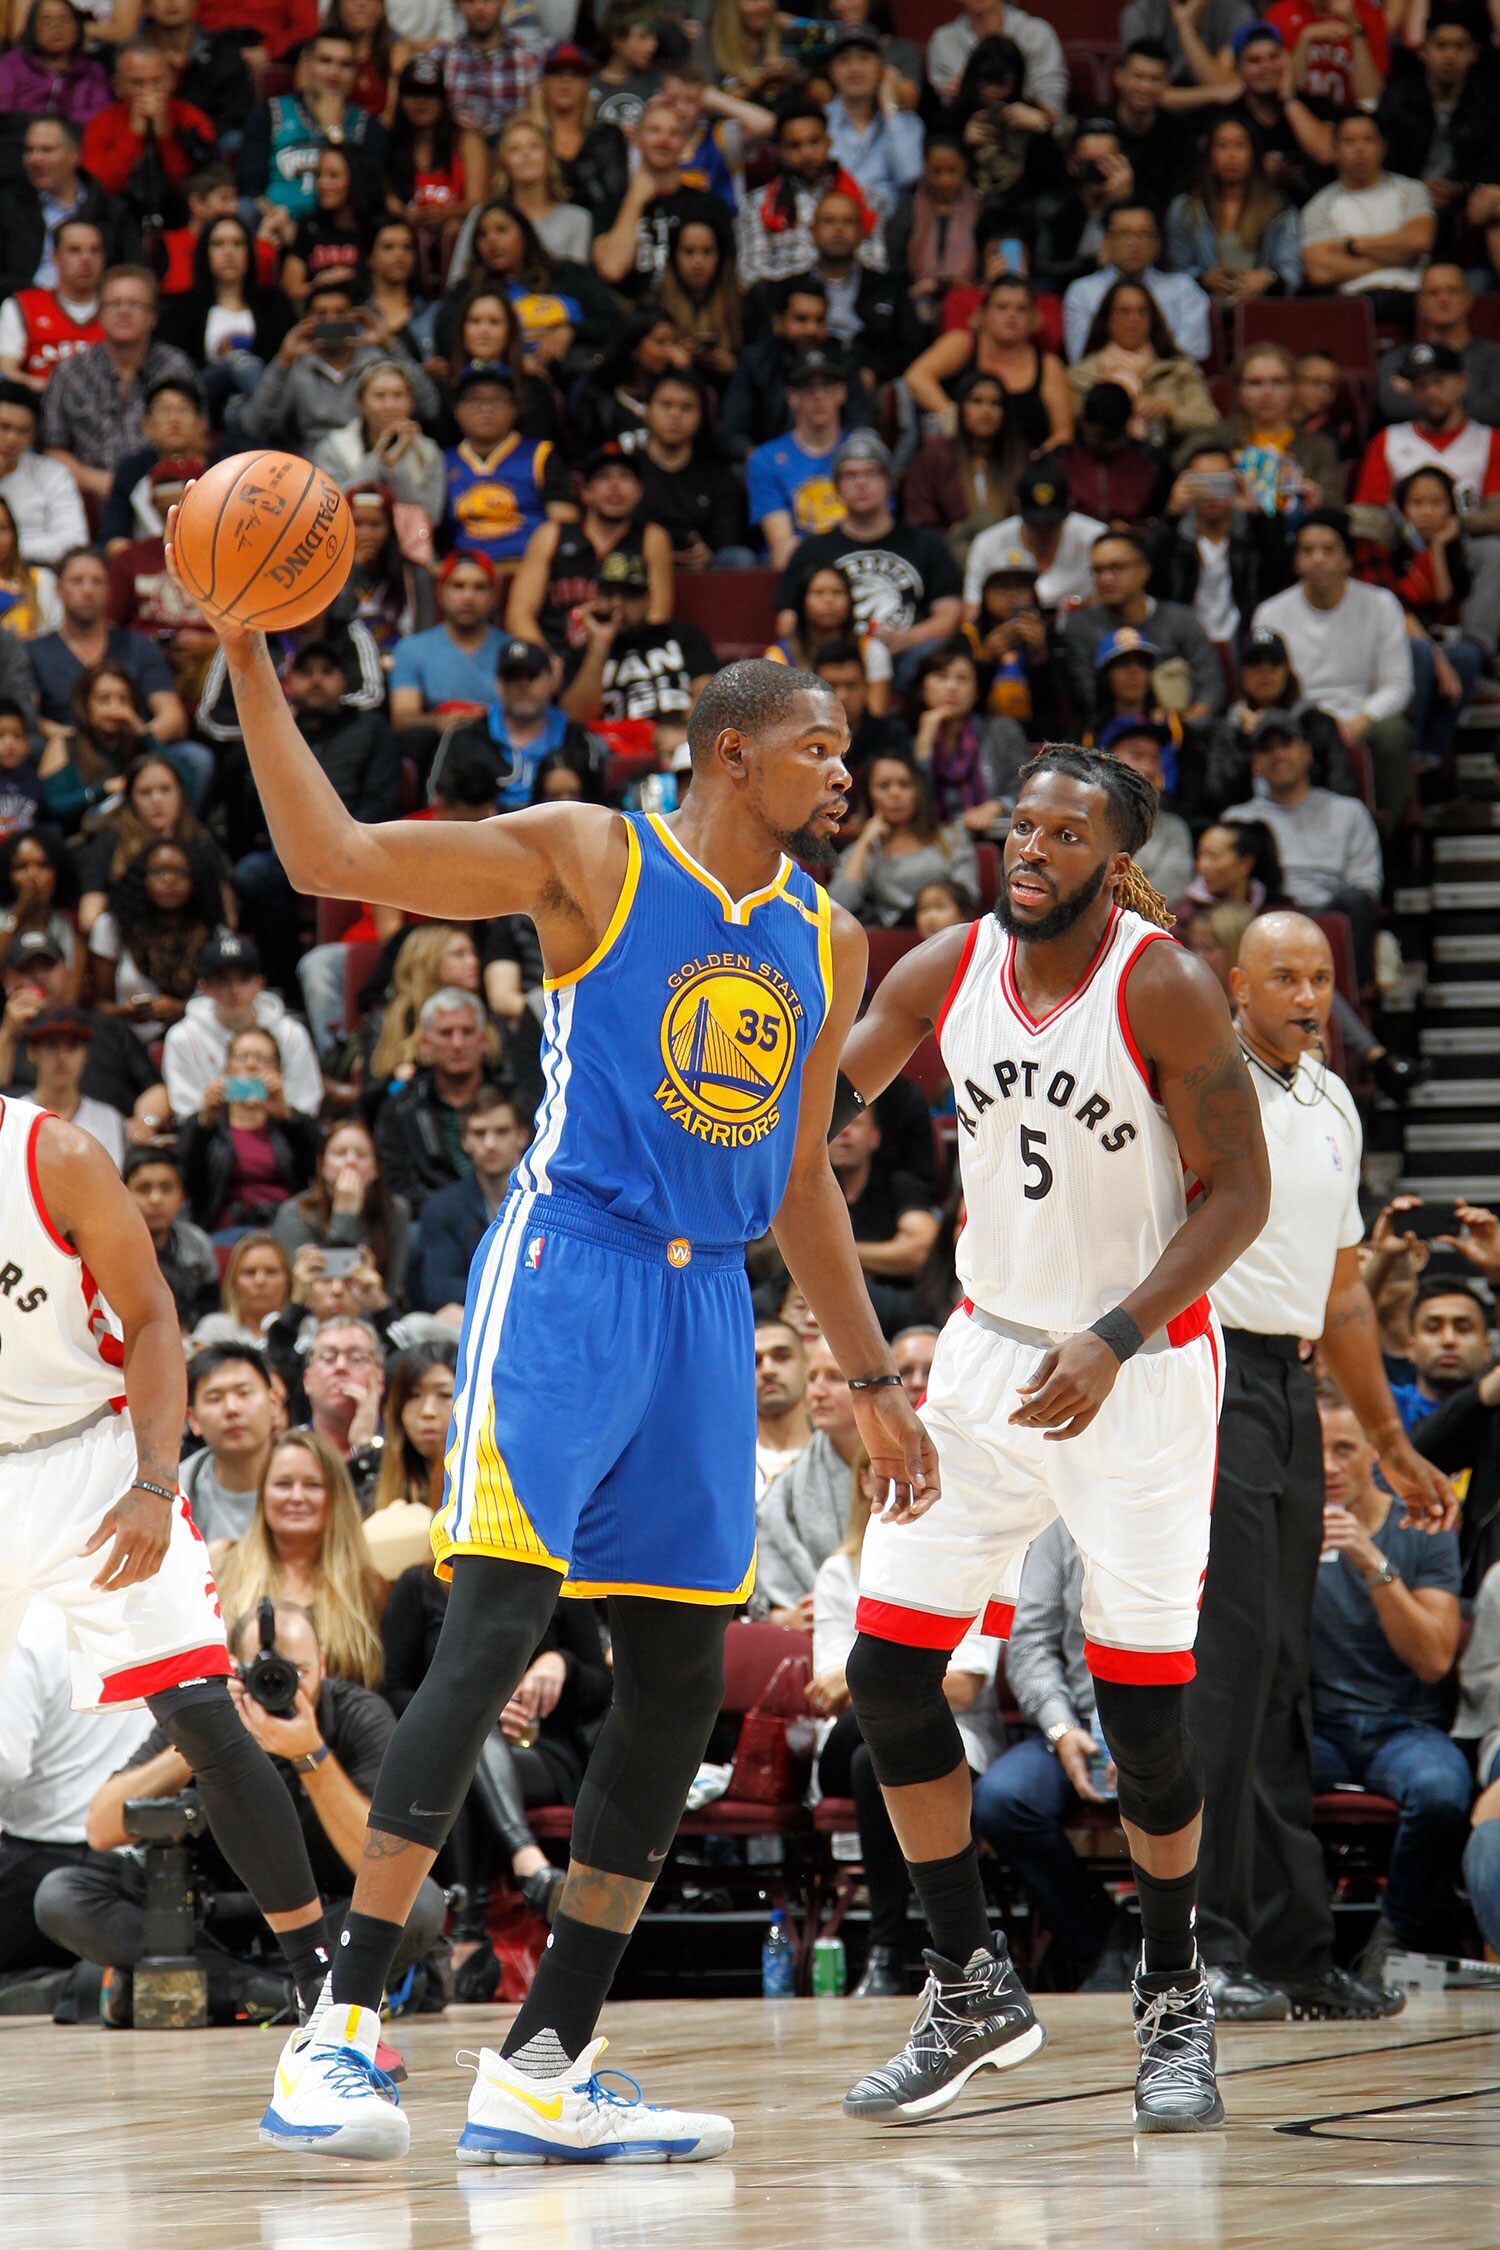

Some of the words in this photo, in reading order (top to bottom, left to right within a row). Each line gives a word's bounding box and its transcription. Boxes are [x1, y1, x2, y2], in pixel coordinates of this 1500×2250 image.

[269, 479, 340, 590] SPALDING
[667, 953, 750, 988] GOLDEN
[758, 962, 804, 1020] STATE
[734, 1008, 781, 1052] 35
[653, 1078, 781, 1148] WARRIORS
[957, 1059, 1138, 1152] RAPTORS
[1020, 1123, 1054, 1201] 5
